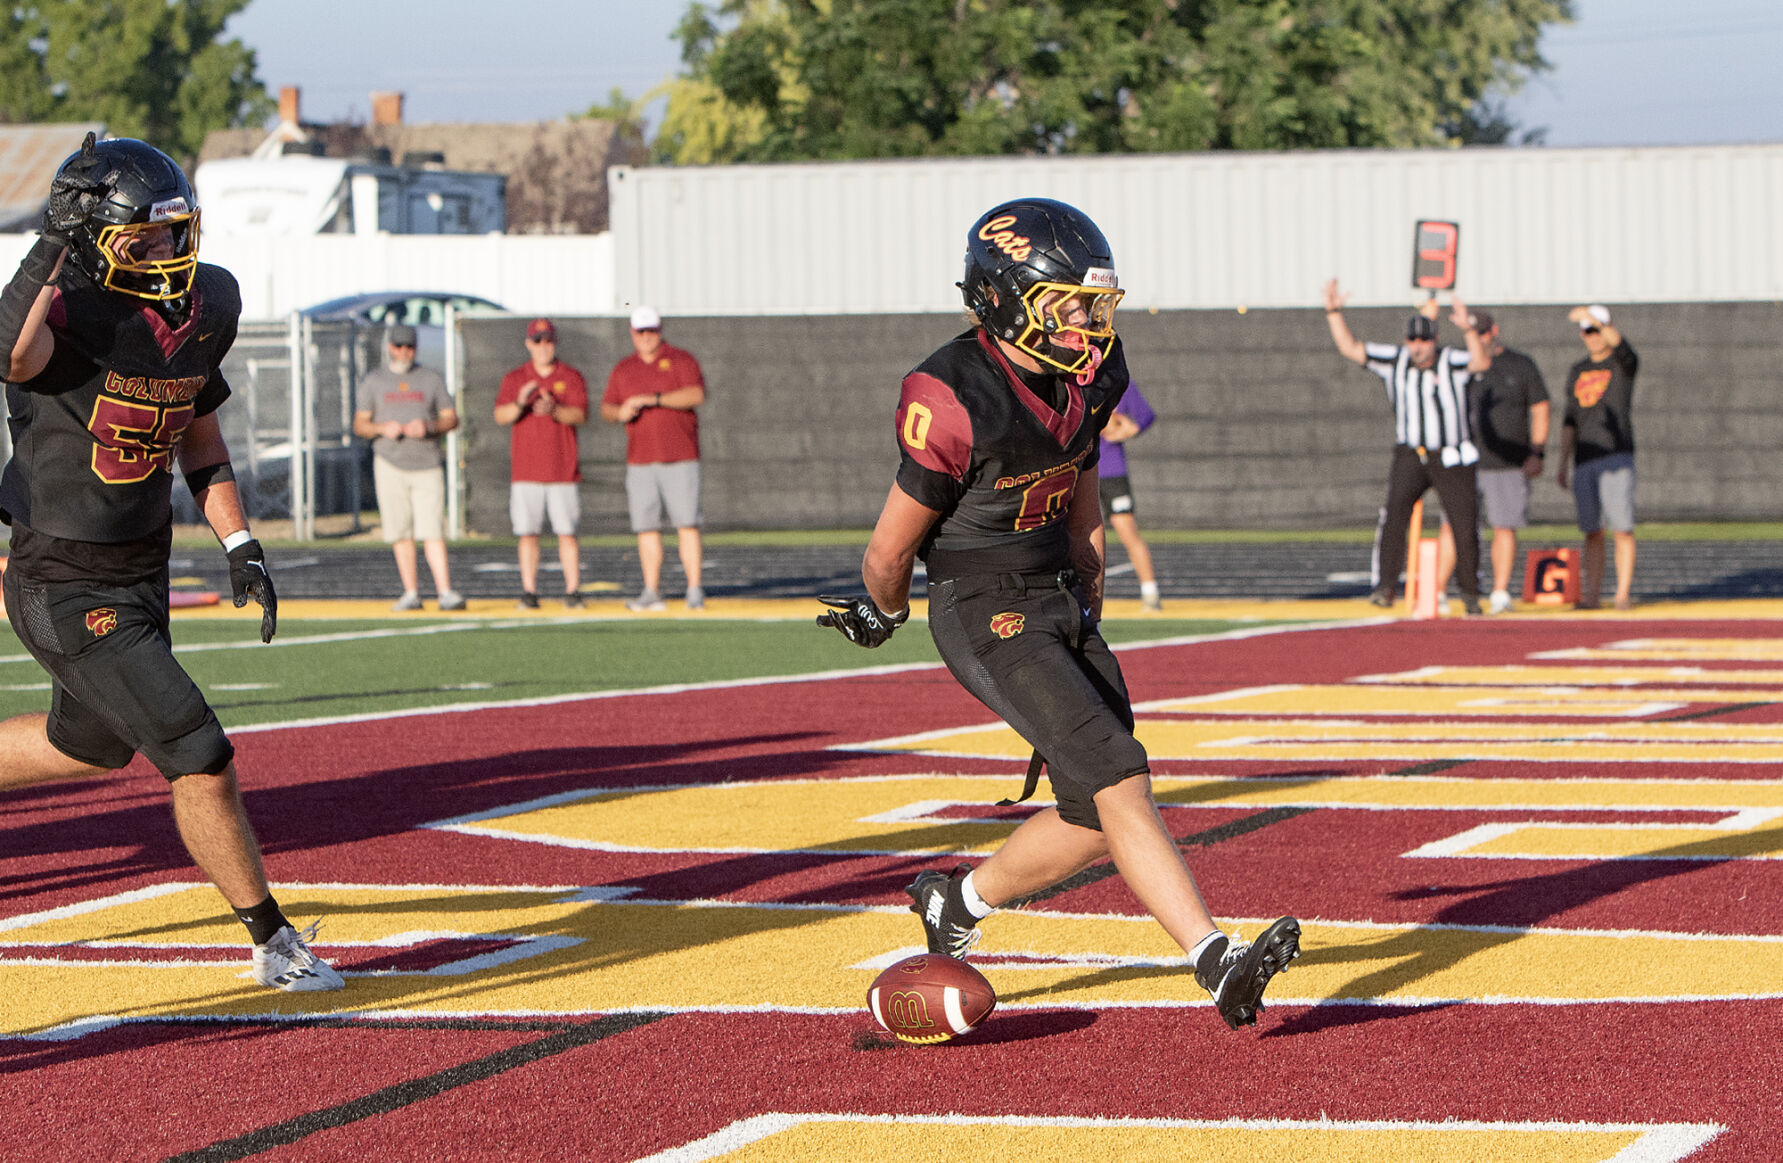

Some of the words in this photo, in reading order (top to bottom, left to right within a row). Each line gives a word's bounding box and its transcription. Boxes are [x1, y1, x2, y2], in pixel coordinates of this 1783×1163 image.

[155, 202, 188, 217] Riddell
[978, 215, 1032, 262] Cats
[1418, 221, 1457, 288] 3
[1091, 272, 1115, 283] Ridde
[105, 369, 207, 404] COLUM
[903, 401, 933, 450] 0
[1534, 557, 1568, 593] G
[925, 888, 946, 930] NIKE
